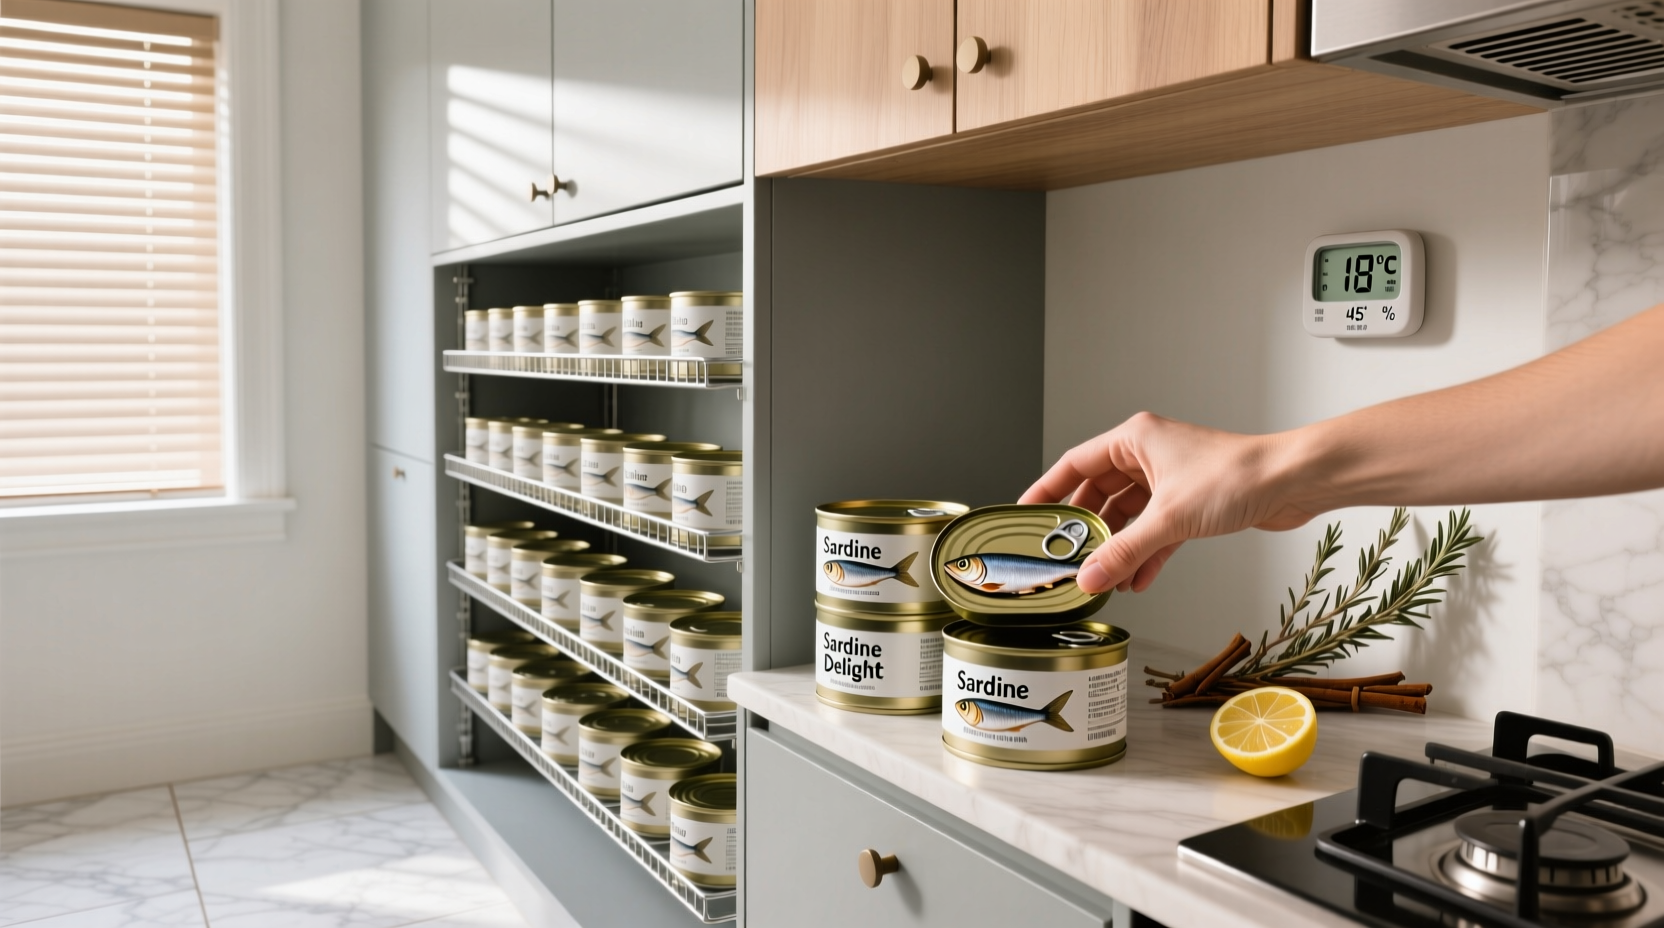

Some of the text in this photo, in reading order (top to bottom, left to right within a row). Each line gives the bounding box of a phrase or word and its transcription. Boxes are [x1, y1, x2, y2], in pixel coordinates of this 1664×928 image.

[1382, 305, 1395, 321] %
[823, 536, 882, 560] Sardine
[823, 632, 882, 657] Sardine
[824, 653, 884, 682] Delight
[957, 669, 1029, 700] Sardine
